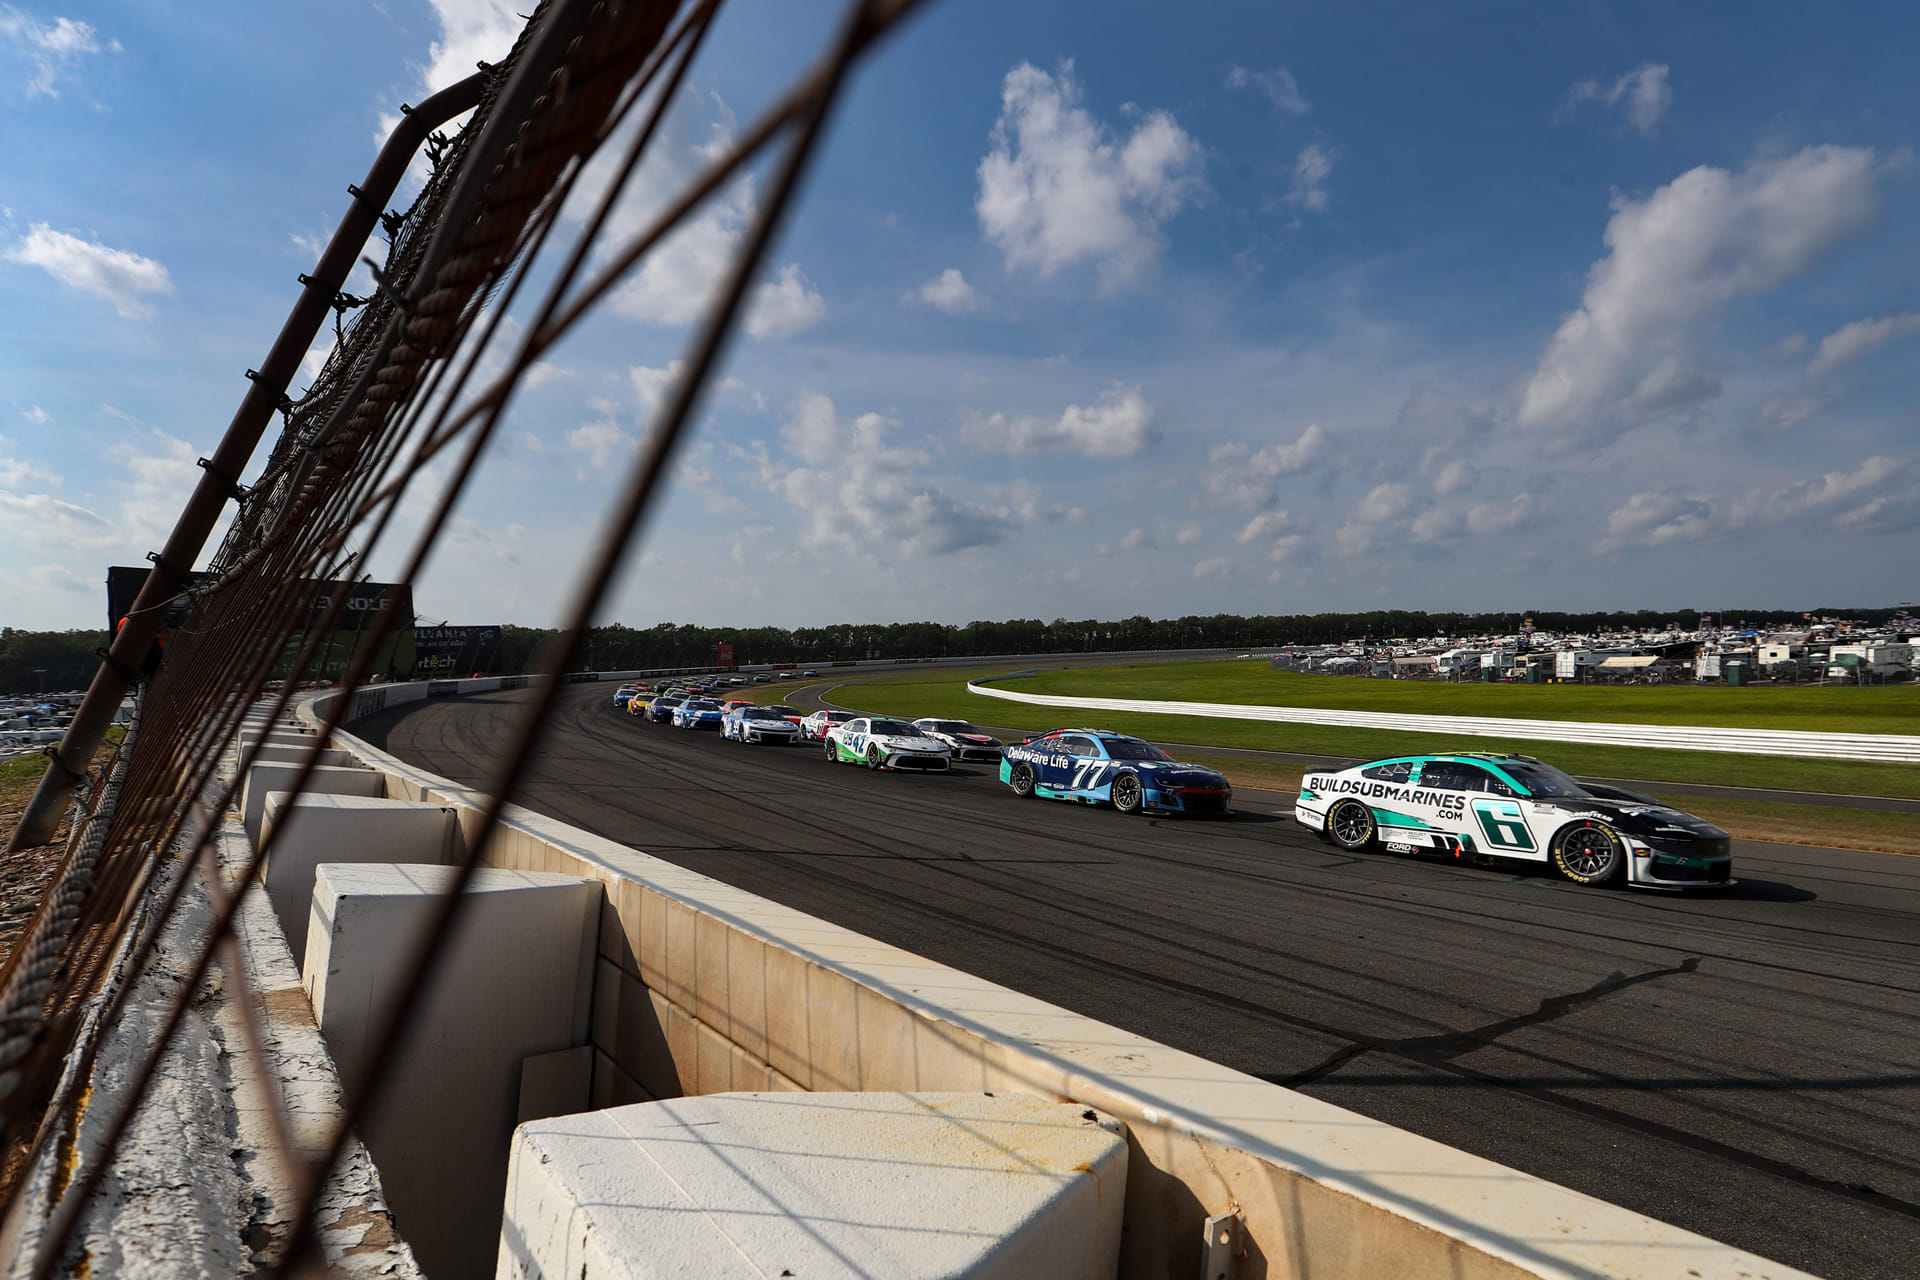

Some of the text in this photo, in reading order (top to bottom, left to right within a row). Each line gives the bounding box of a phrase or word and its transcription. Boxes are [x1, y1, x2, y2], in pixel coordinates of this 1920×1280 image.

[1007, 746, 1069, 770] Delaware Life
[1071, 758, 1111, 791] 77
[1309, 777, 1467, 810] BUILDSUBMARINES
[1436, 810, 1463, 821] .COM
[1474, 800, 1535, 850] 6
[1386, 842, 1412, 851] FORD
[1675, 856, 1689, 865] 6
[1554, 847, 1590, 884] GOODYEAR
